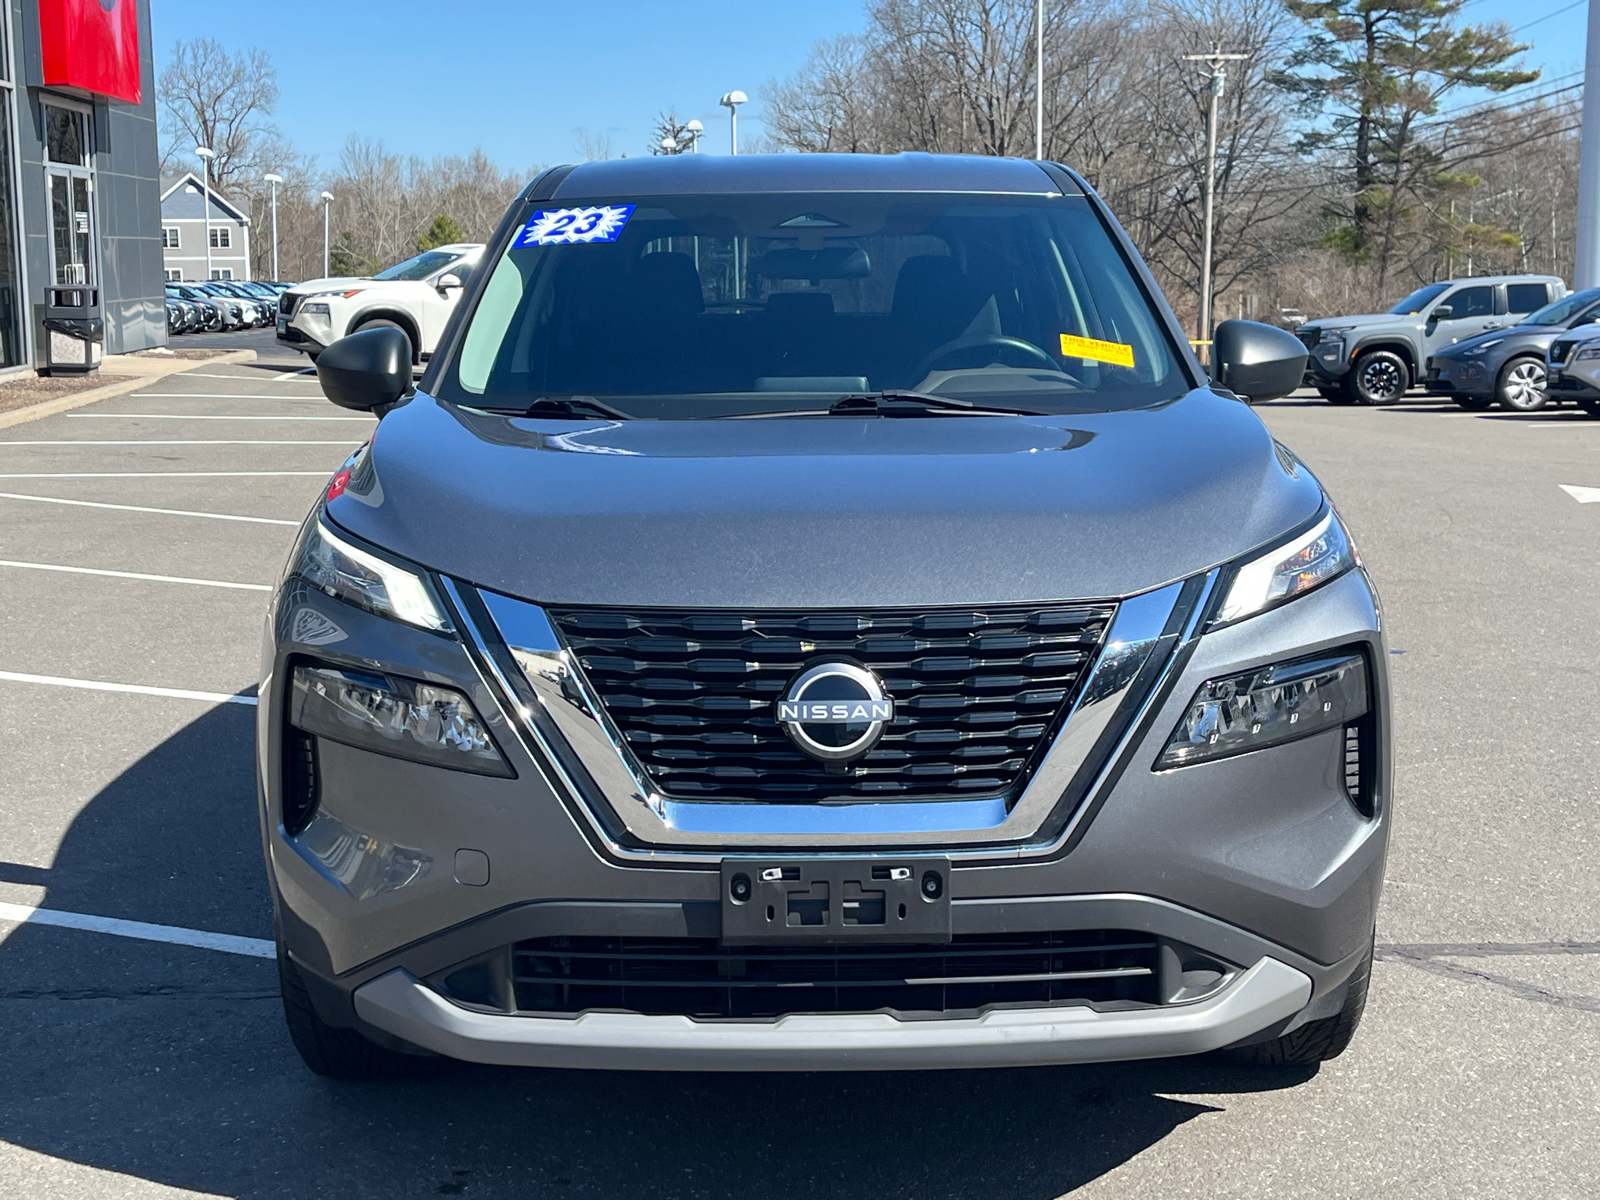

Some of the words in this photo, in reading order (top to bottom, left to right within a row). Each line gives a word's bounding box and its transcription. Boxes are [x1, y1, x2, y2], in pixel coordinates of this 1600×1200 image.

[543, 213, 603, 237] 23
[1063, 336, 1085, 344] THIS
[1089, 340, 1130, 352] VEHICLE
[781, 704, 889, 719] NISSAN
